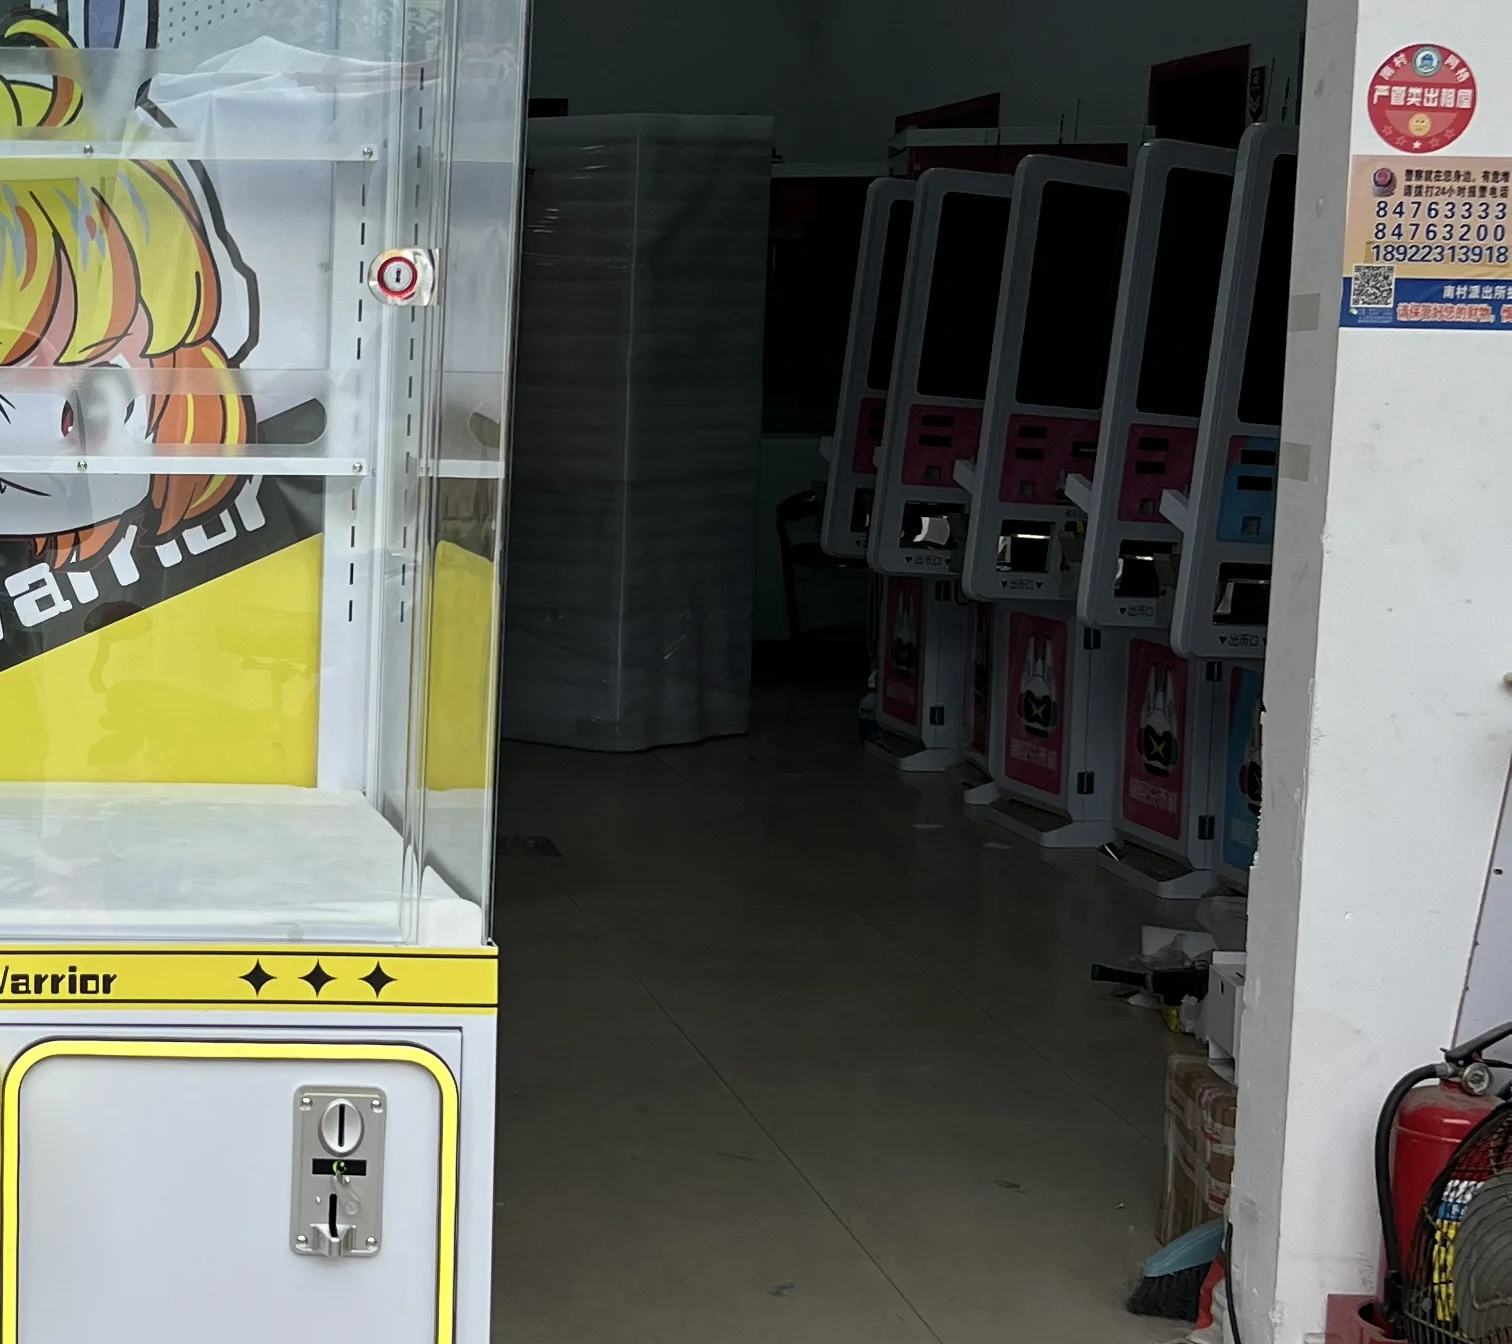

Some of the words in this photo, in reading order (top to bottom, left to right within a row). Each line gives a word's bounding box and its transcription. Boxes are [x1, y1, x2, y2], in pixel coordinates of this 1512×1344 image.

[1376, 201, 1507, 219] 84763333
[1374, 222, 1506, 241] 84763200
[1372, 244, 1509, 263] 18922313918
